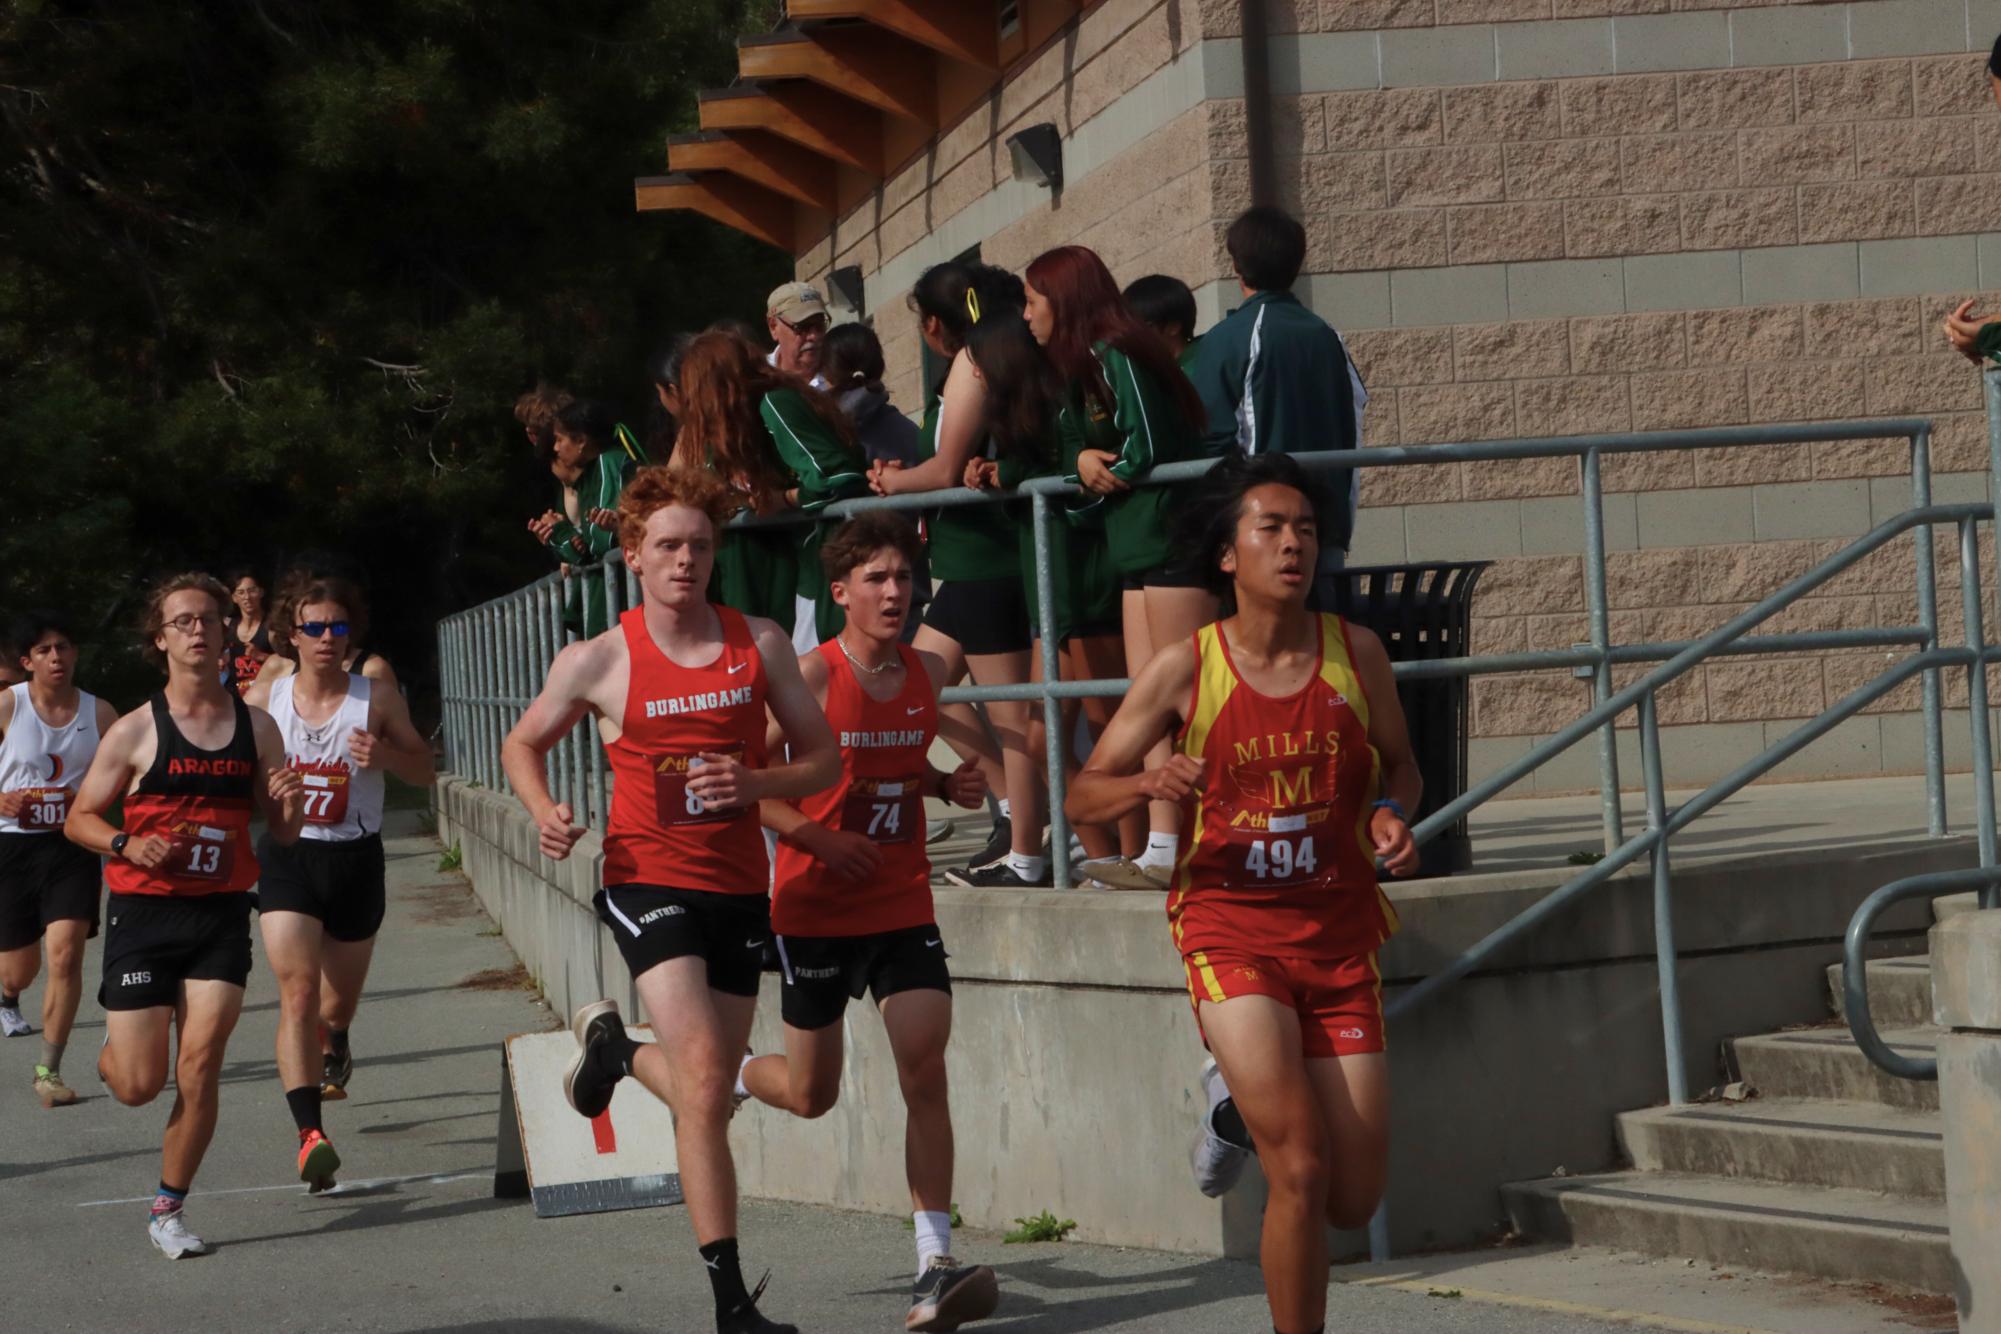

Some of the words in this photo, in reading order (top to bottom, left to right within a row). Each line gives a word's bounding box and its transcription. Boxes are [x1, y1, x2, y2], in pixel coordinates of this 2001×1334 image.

[645, 686, 752, 718] BURLINGAME
[840, 730, 925, 747] BURLINGAME
[1233, 731, 1340, 766] MILLS
[168, 757, 251, 776] ARAGON
[1270, 766, 1318, 808] M
[30, 803, 66, 825] 301
[304, 789, 334, 816] 77
[867, 803, 901, 836] 74
[187, 844, 221, 873] 13
[1245, 836, 1317, 878] 494
[121, 971, 151, 986] AHS
